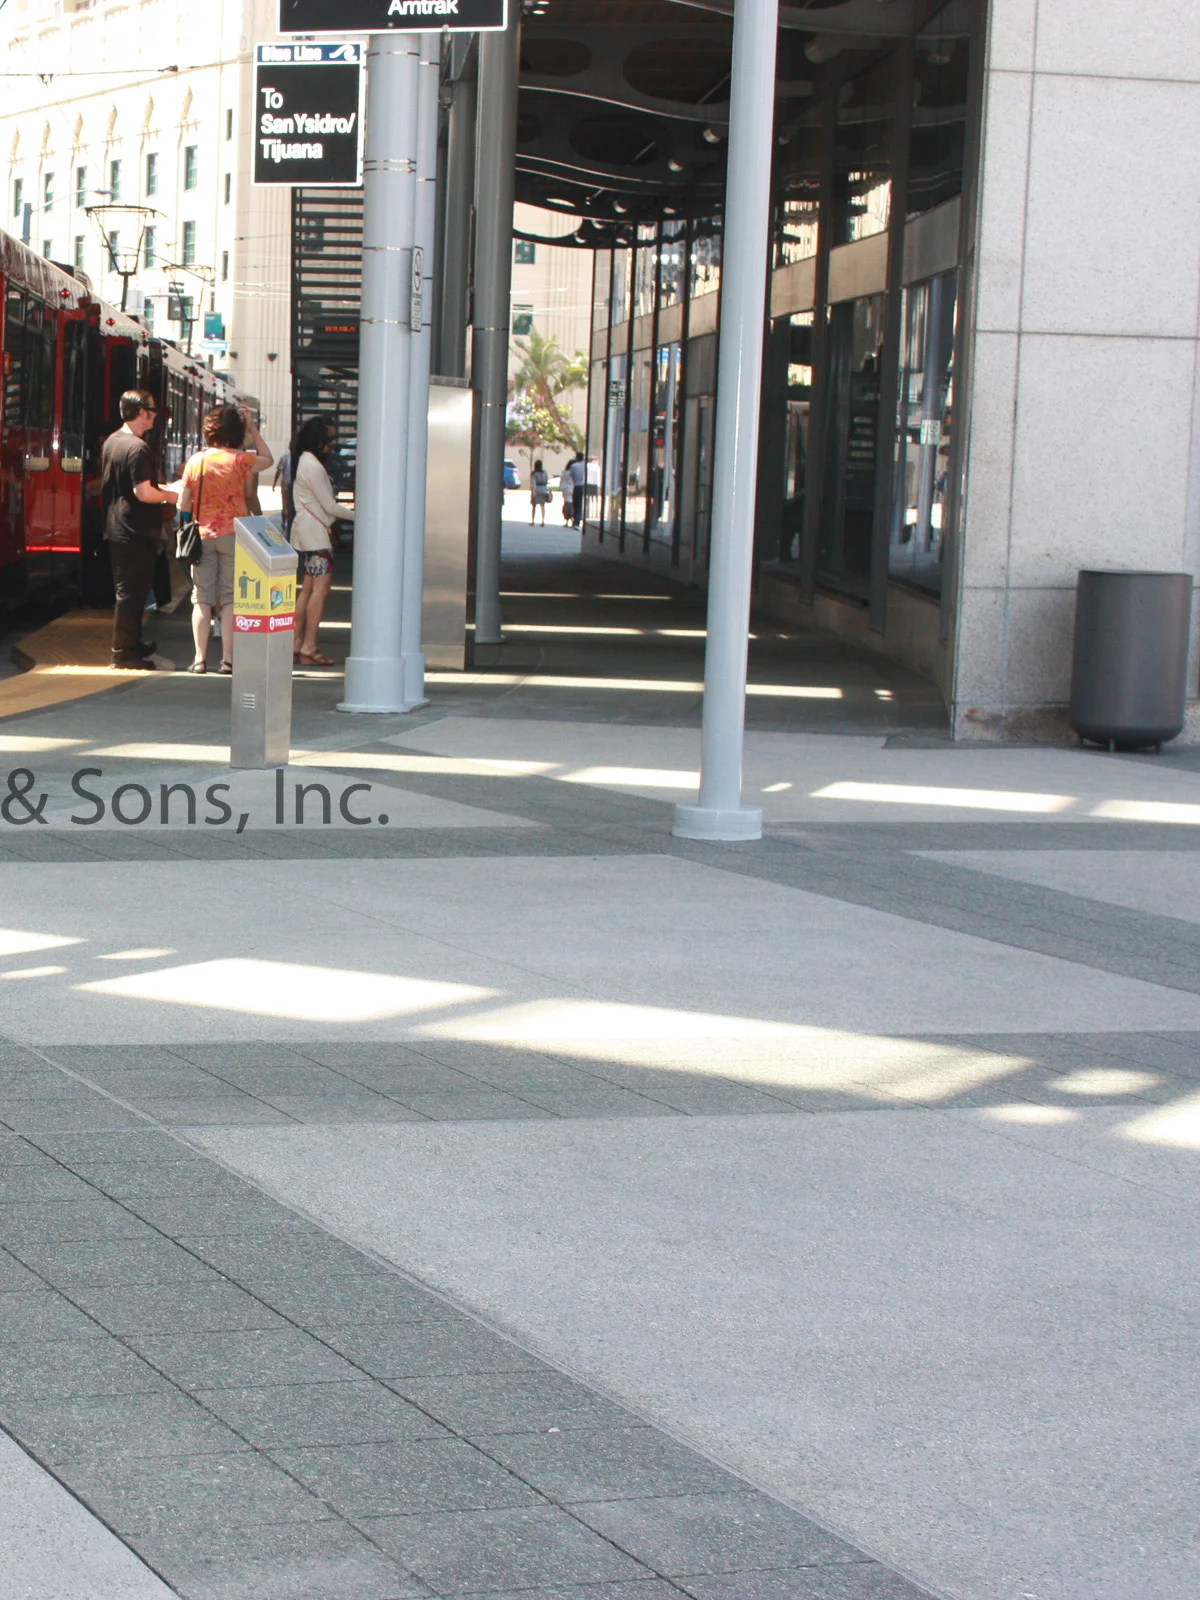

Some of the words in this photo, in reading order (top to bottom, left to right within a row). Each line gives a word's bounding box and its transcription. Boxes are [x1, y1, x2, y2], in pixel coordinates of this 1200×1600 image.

[388, 0, 458, 15] Amtrak
[294, 46, 322, 61] Line
[261, 88, 284, 109] To
[261, 114, 293, 134] San
[294, 112, 356, 134] Ysidro/
[260, 139, 323, 163] Tijuana
